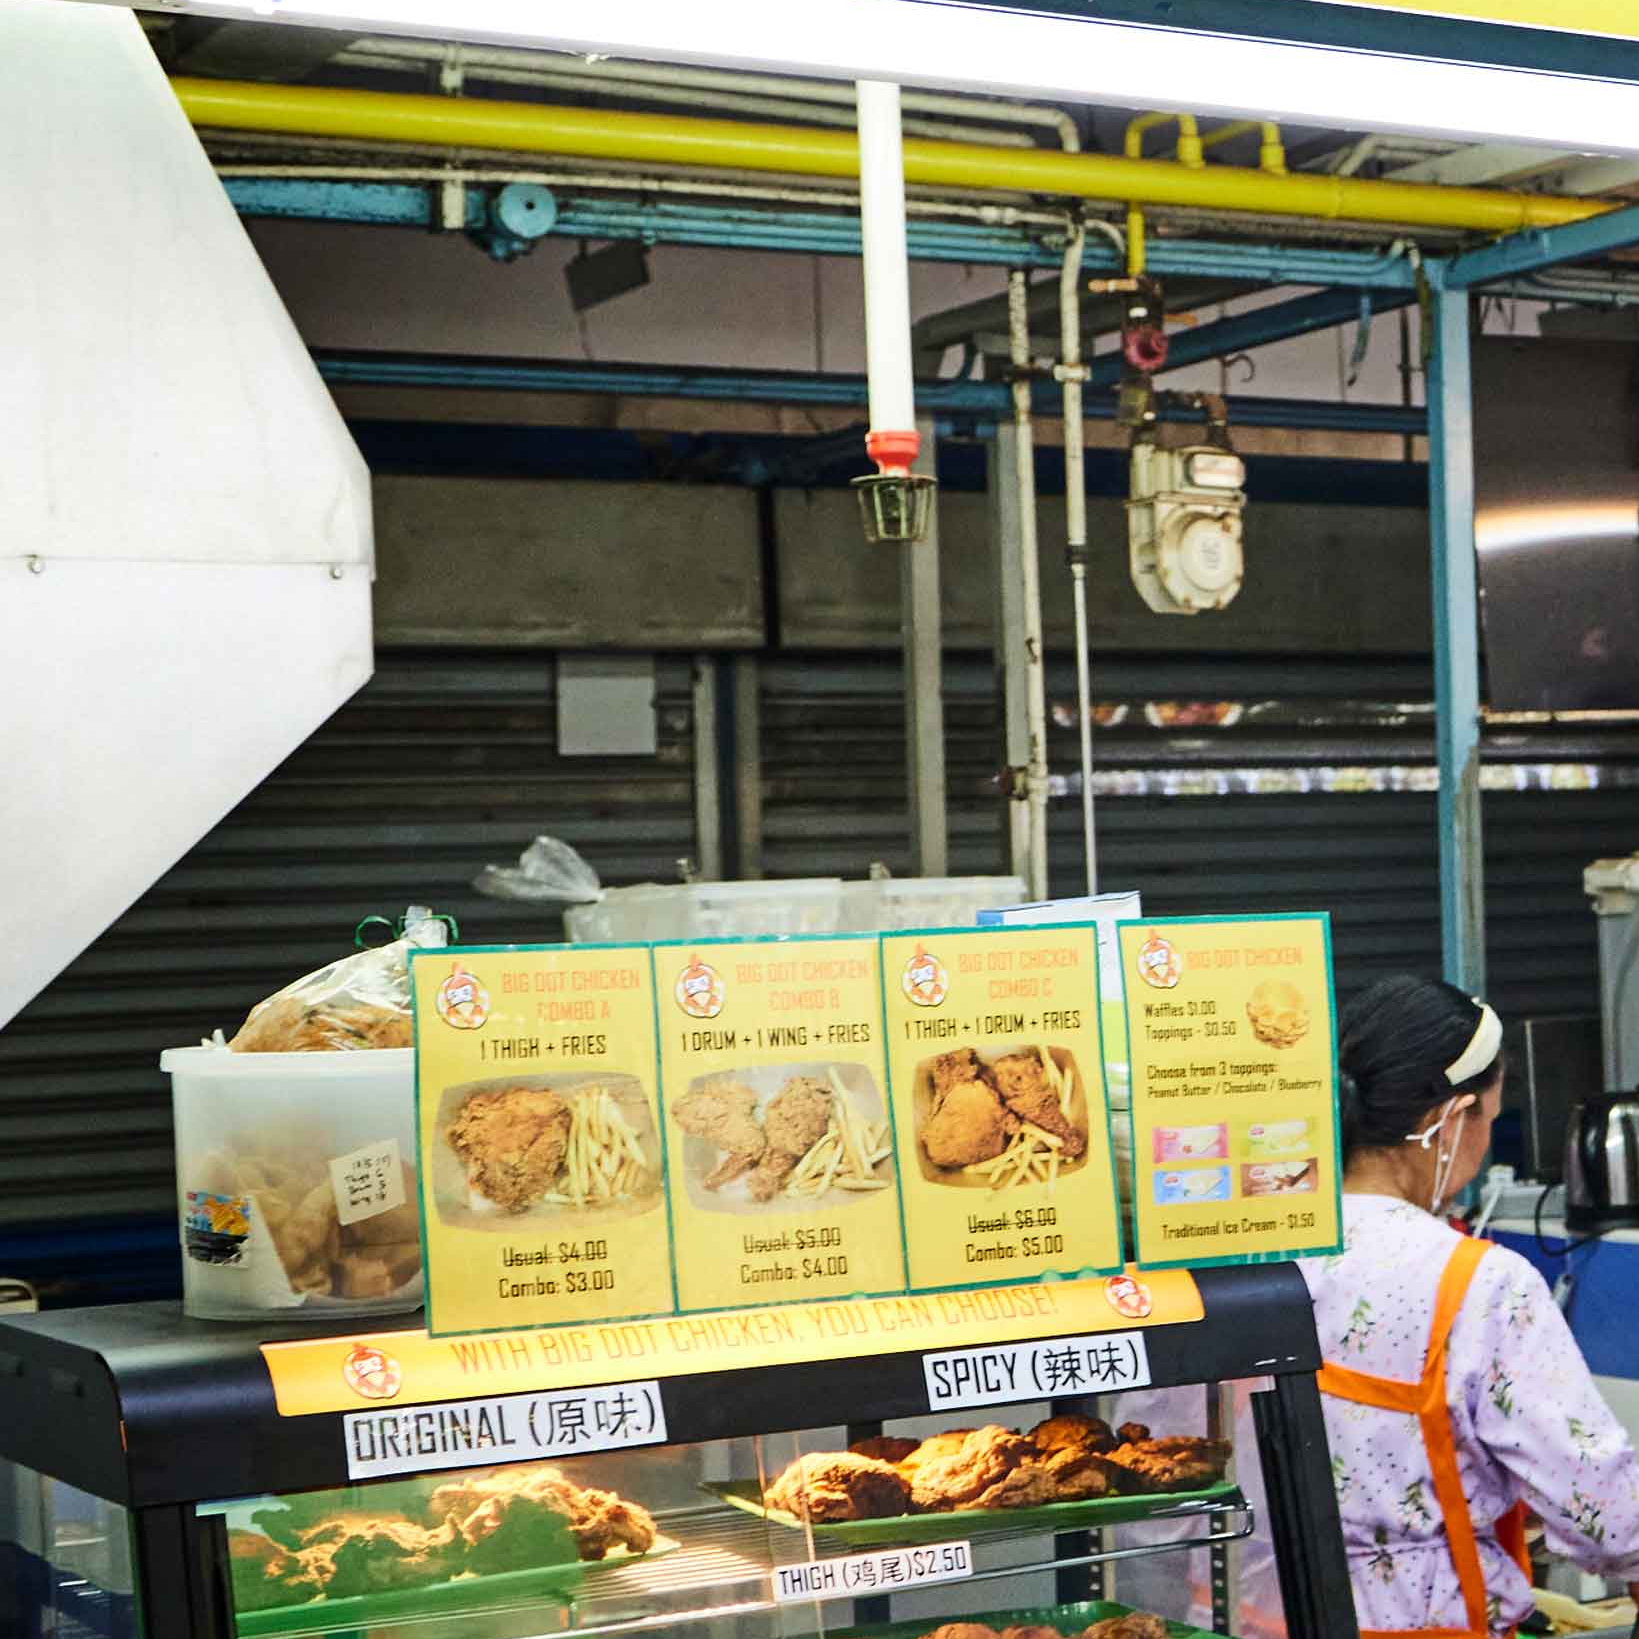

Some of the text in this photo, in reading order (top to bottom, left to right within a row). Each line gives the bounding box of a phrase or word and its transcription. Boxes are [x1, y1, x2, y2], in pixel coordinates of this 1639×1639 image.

[959, 949, 1078, 973] BIG DOT CHICKEN
[1245, 946, 1302, 966] CHICKEN
[502, 968, 641, 995] BIG DOT CHICKEN
[736, 959, 868, 984] BIG DOT CHICKEN
[989, 977, 1053, 1000] COMBO C
[537, 999, 611, 1022] COMBO A
[769, 991, 824, 1012] COMBO
[1144, 1000, 1216, 1018] Waffles $1.00
[915, 1019, 957, 1039] THIGH
[984, 1014, 1025, 1035] DRUM
[1043, 1010, 1081, 1030] FRIES
[1145, 1021, 1236, 1042] Toppings $0.50
[491, 1036, 540, 1058] THIGH
[562, 1034, 606, 1056] FRIES
[693, 1031, 736, 1052] DRUM
[769, 1028, 807, 1048] WING
[828, 1024, 870, 1044] FRIES
[1147, 1061, 1278, 1080] Choose from 3 toppings:
[1148, 1085, 1179, 1099] Peanut
[1182, 1084, 1212, 1098] Butter
[1223, 1080, 1267, 1094] Chocolate
[1278, 1077, 1322, 1092] Blueberry
[1015, 1207, 1057, 1229] $6.00
[1161, 1212, 1315, 1240] Traditional Ice Cream $1.50
[795, 1227, 841, 1250] $5.00
[965, 1235, 1063, 1263] Combo: $5.00
[558, 1239, 607, 1264] $4.00
[741, 1256, 848, 1284] Combo: $4.00
[498, 1269, 615, 1299] Combo: $3.00
[451, 1336, 528, 1374] WITH
[542, 1331, 594, 1366] BIG
[600, 1324, 661, 1360] DOT
[807, 1304, 869, 1339] YOU
[880, 1299, 936, 1332] CAN
[941, 1283, 1059, 1327] CHOOSE!
[932, 1341, 1139, 1399] SPICY (辣味)
[352, 1388, 657, 1462] ORIGINAL (原味)
[778, 1567, 836, 1595] THIGH
